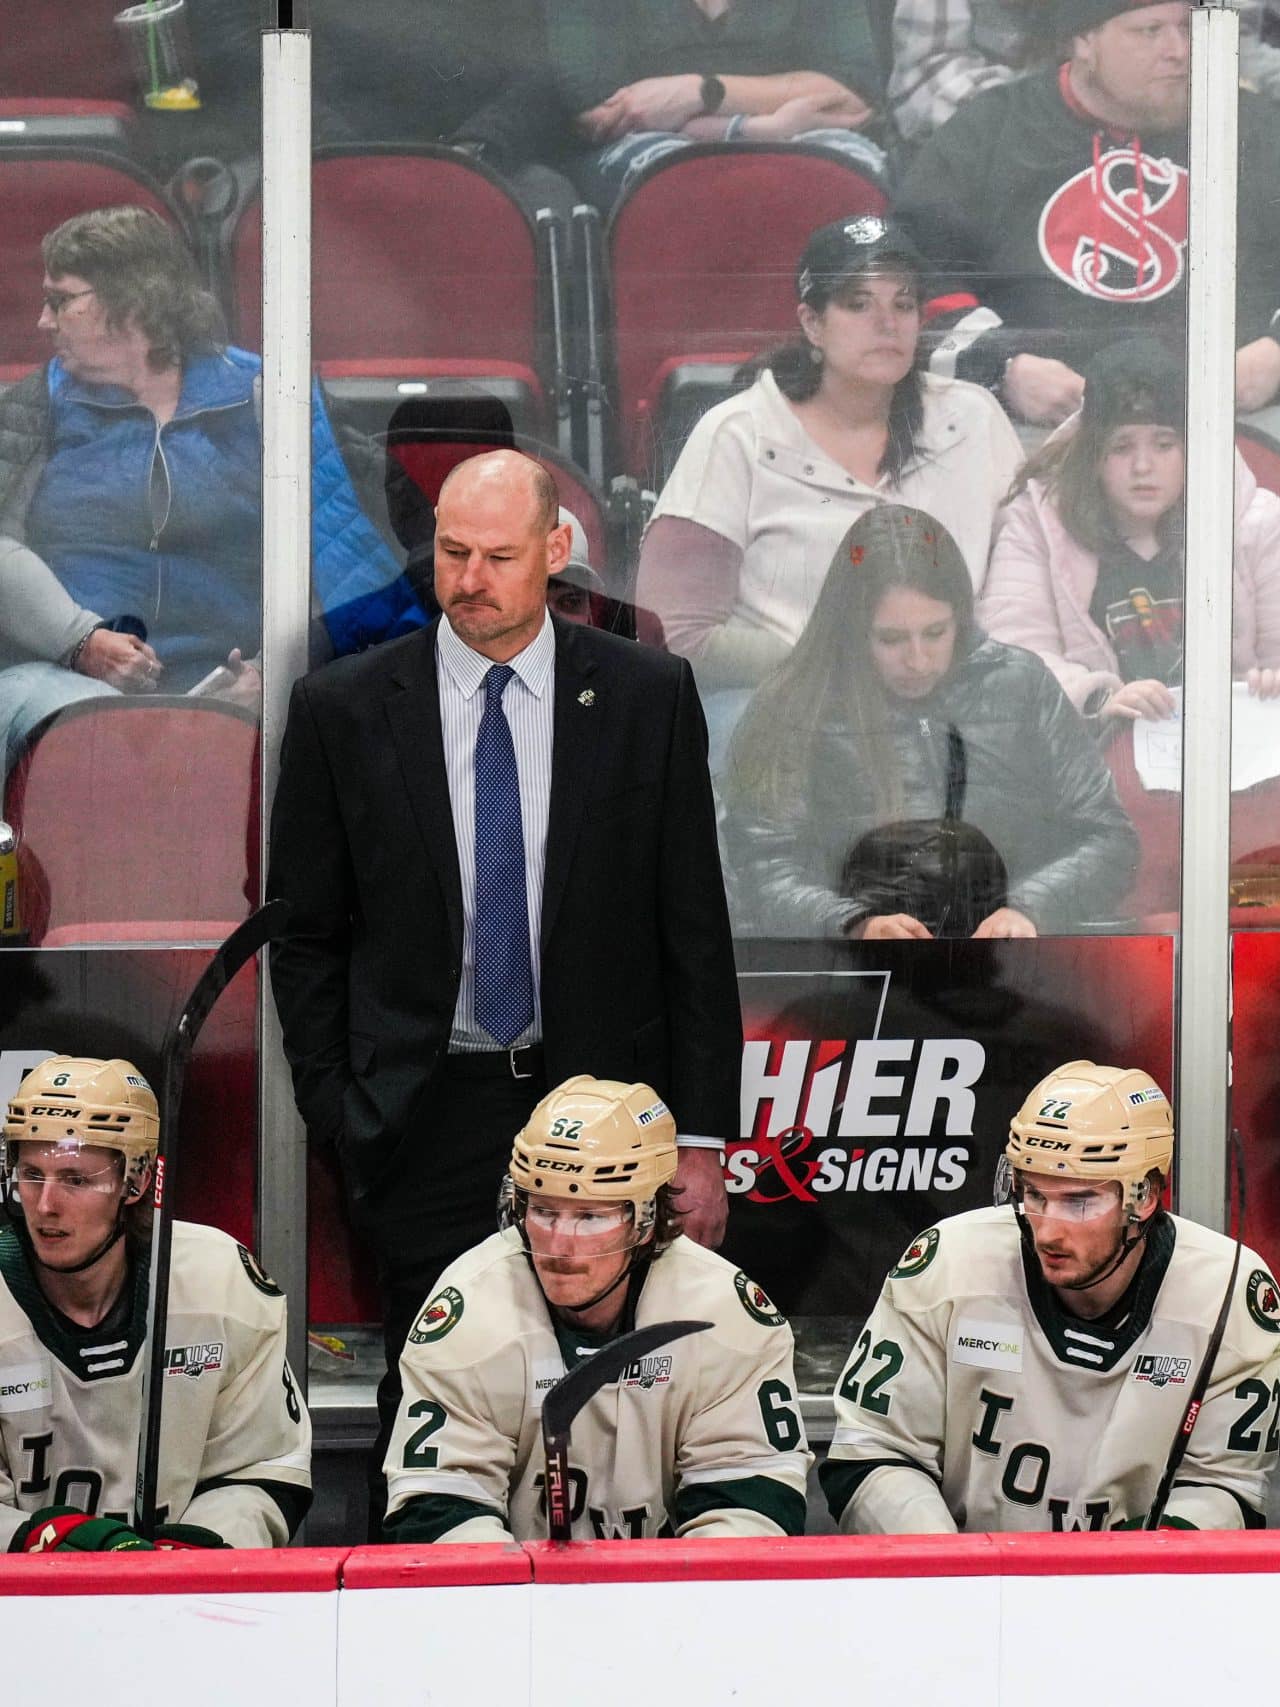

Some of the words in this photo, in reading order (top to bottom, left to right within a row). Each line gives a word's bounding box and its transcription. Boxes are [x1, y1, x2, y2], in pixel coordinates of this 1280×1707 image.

[31, 1106, 81, 1118] CCM
[1038, 1099, 1072, 1119] 22
[551, 1118, 583, 1140] 62
[1025, 1137, 1072, 1151] CCM
[535, 1158, 584, 1173] CCM
[154, 1159, 166, 1204] CCM
[959, 1336, 1020, 1354] MERCYONE
[839, 1329, 904, 1416] 22
[0, 1377, 48, 1396] ERCYONE
[757, 1379, 802, 1452] 6
[1183, 1403, 1200, 1432] CCM
[403, 1399, 448, 1469] 2
[548, 1453, 564, 1526] TRUE
